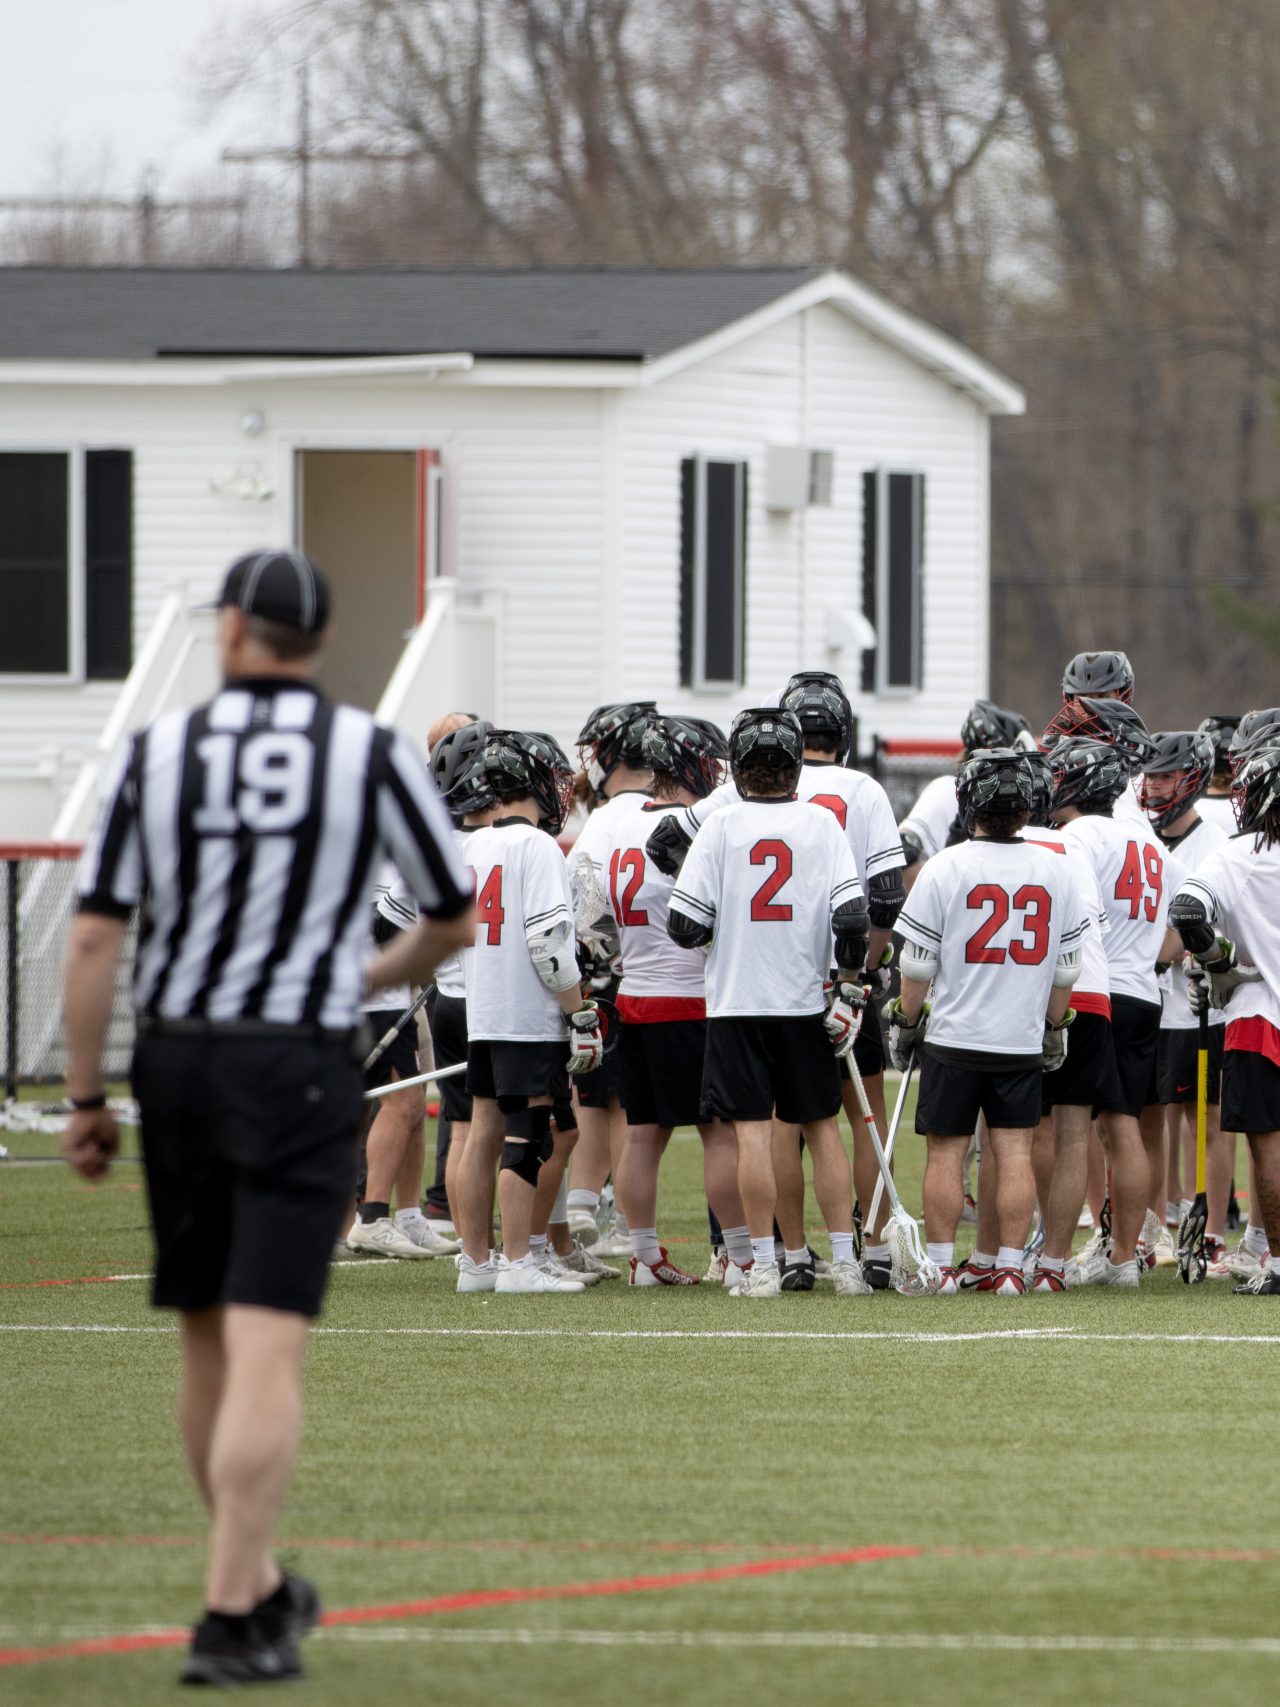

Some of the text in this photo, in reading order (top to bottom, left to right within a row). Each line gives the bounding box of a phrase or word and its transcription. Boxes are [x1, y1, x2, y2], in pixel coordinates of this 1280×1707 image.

[762, 723, 773, 732] 02
[193, 732, 315, 833] 19
[609, 847, 649, 928] 12
[750, 839, 792, 921] 2
[1114, 840, 1163, 923] 49
[965, 884, 1052, 965] 23
